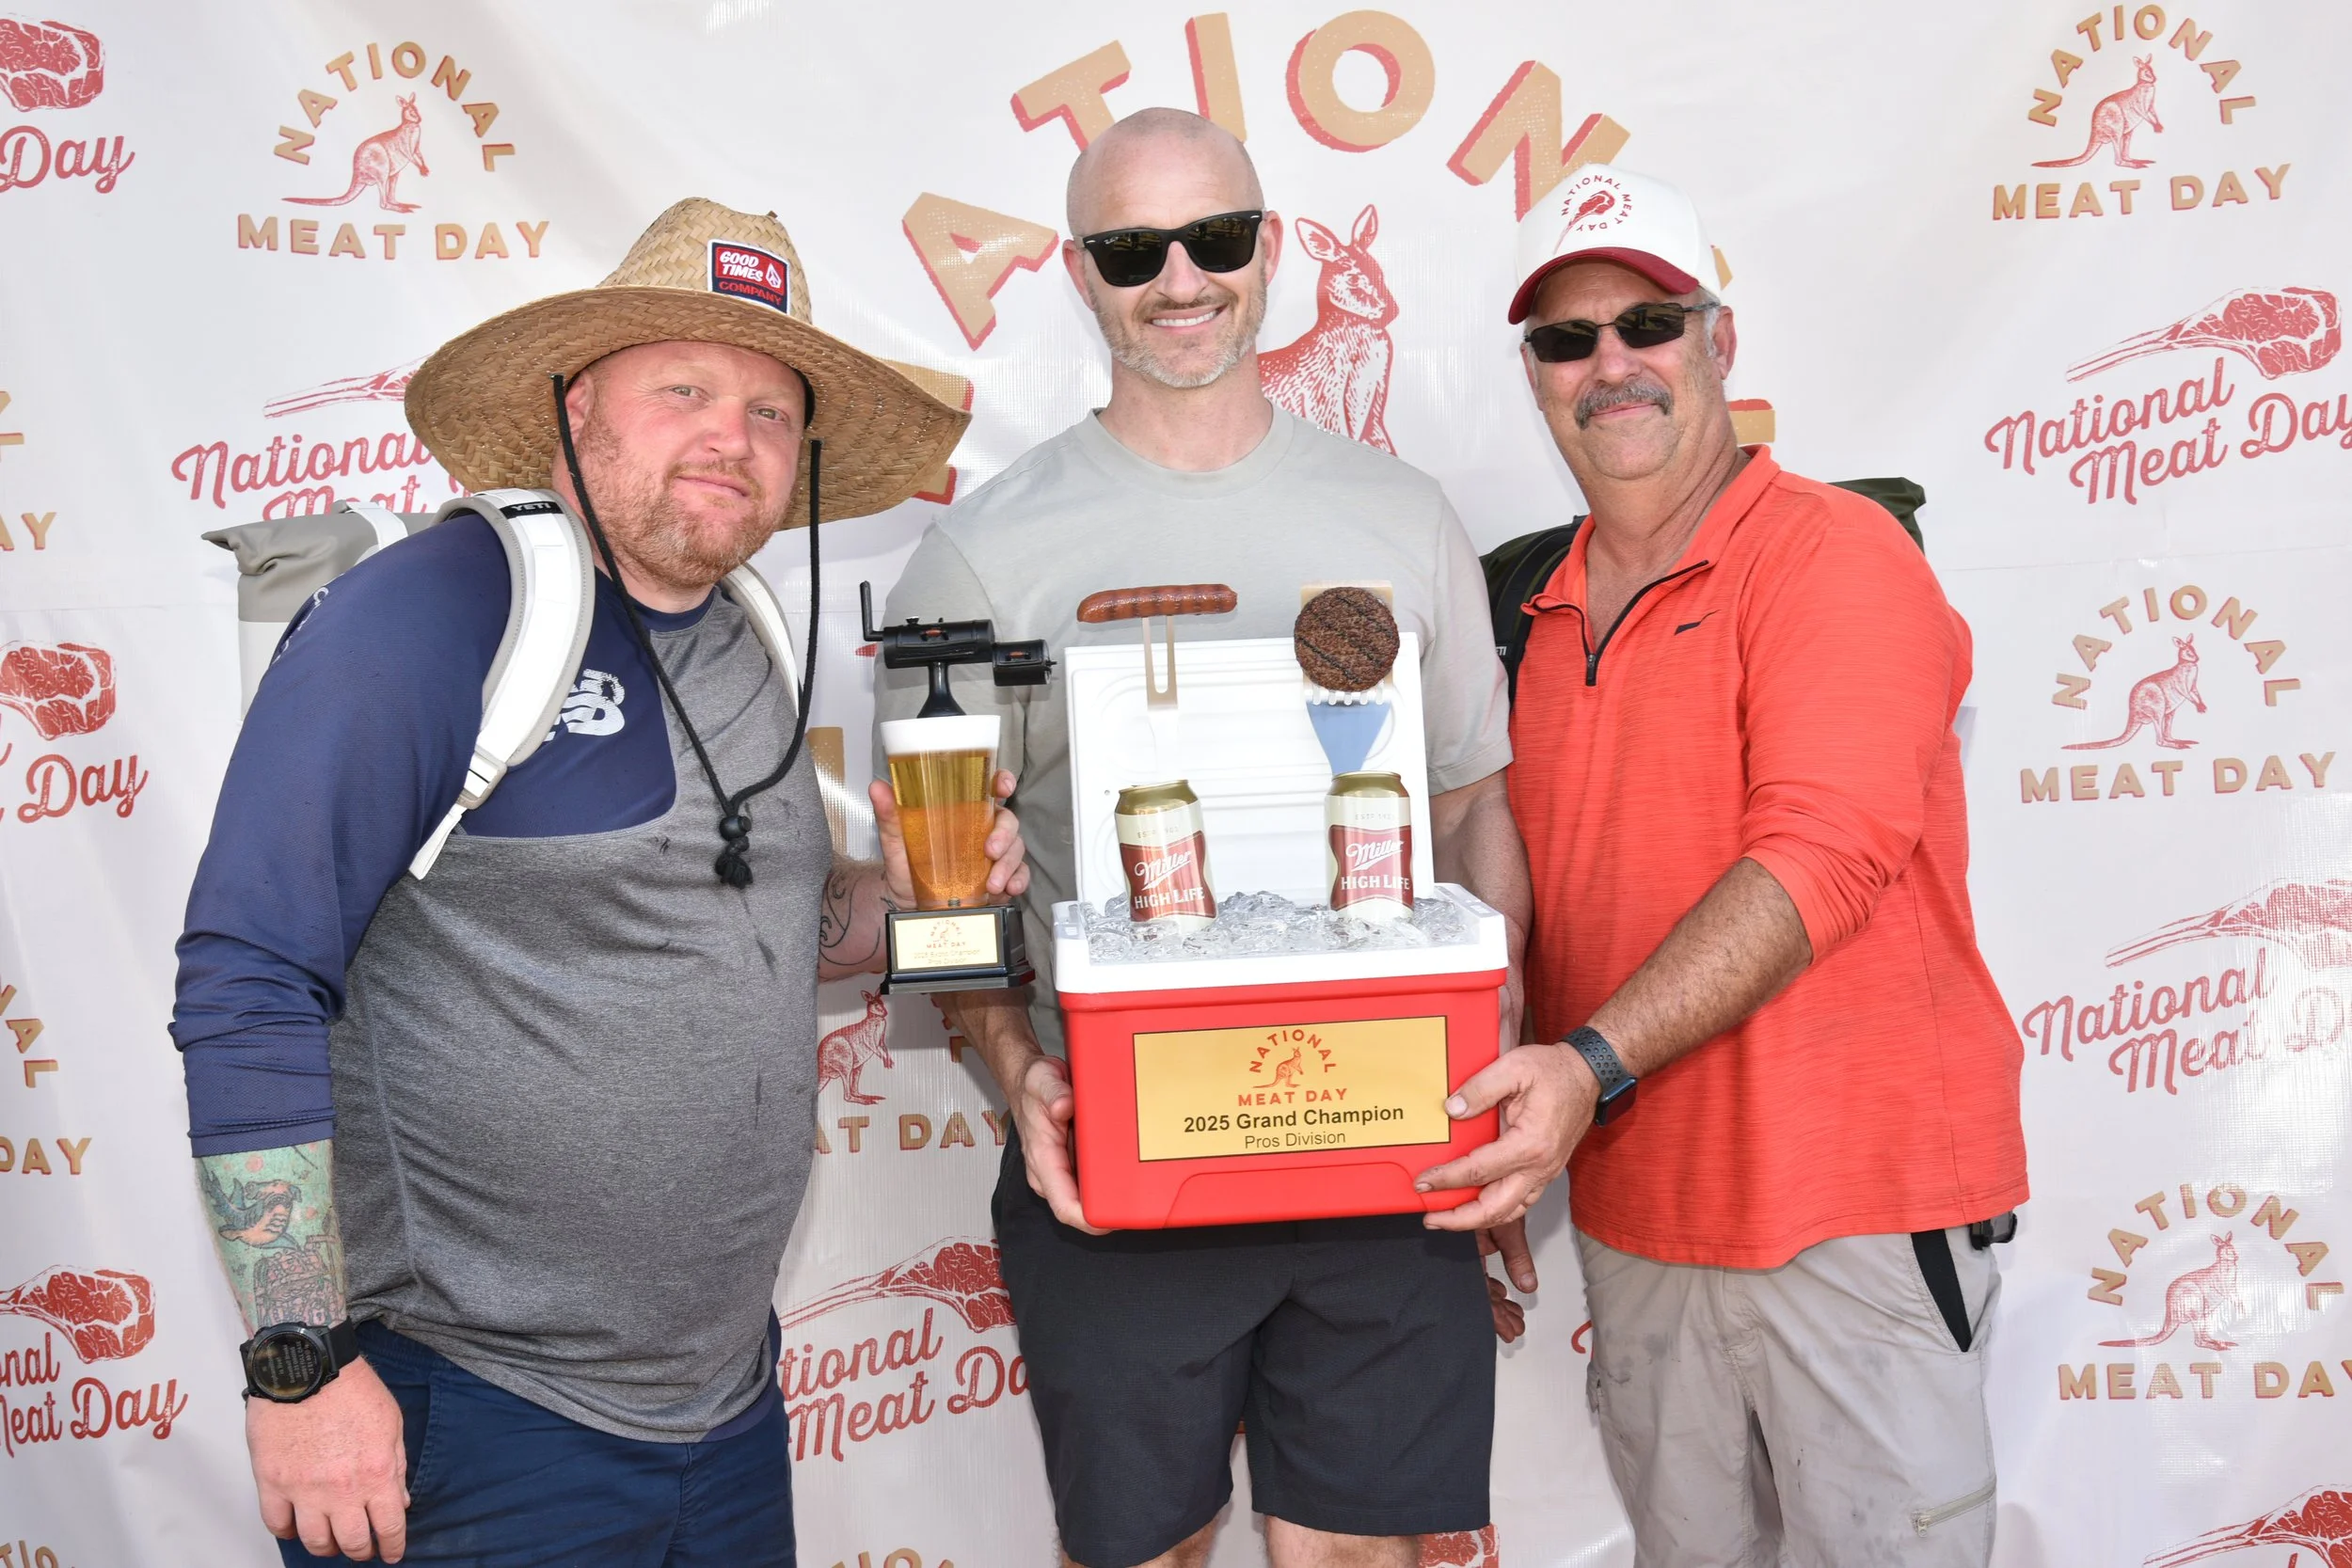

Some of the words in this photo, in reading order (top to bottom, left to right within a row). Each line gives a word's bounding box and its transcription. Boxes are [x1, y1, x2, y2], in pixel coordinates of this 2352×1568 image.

[2028, 4, 2256, 127] NATIONAL
[274, 41, 516, 172] NATIONAL
[0, 125, 135, 194] Day
[1562, 175, 1620, 216] NATIONAL
[1614, 194, 1632, 224] MEAT
[1992, 180, 2140, 221] MEAT
[2170, 163, 2292, 212] DAY
[237, 214, 405, 260] MEAT
[436, 220, 549, 260] DAY
[1576, 222, 1608, 231] DAY
[720, 251, 759, 268] GOOD
[723, 263, 764, 282] TIMES
[719, 281, 782, 306] COMPANY
[1984, 356, 2234, 476] National
[2070, 419, 2229, 505] Meat
[511, 502, 551, 511] YETI
[2052, 584, 2301, 710] NATIONAL
[17, 753, 150, 824] Day
[2020, 760, 2184, 803] MEAT
[2213, 752, 2336, 794] DAY
[1134, 850, 1192, 888] Miller
[1344, 839, 1405, 869] Miller
[1134, 892, 1171, 910] HIGH
[1172, 887, 1205, 903] LIFE
[1341, 875, 1379, 891] HIGH
[1383, 875, 1410, 890] LIFE
[2022, 946, 2277, 1062] National
[1249, 1029, 1337, 1073] NATIONAL
[1237, 1091, 1295, 1106] MEAT
[1306, 1087, 1347, 1102] DAY
[898, 1110, 1012, 1151] DAY
[1184, 1115, 1230, 1132] 2025
[1236, 1111, 1297, 1130] Grand
[1303, 1105, 1405, 1127] Champion
[1245, 1133, 1279, 1148] Pros
[1285, 1131, 1346, 1147] Division
[2088, 1182, 2344, 1310] NATIONAL
[779, 1307, 945, 1402] tional
[2058, 1362, 2221, 1400] MEAT
[70, 1377, 189, 1440] Day
[787, 1370, 935, 1463] Meat
